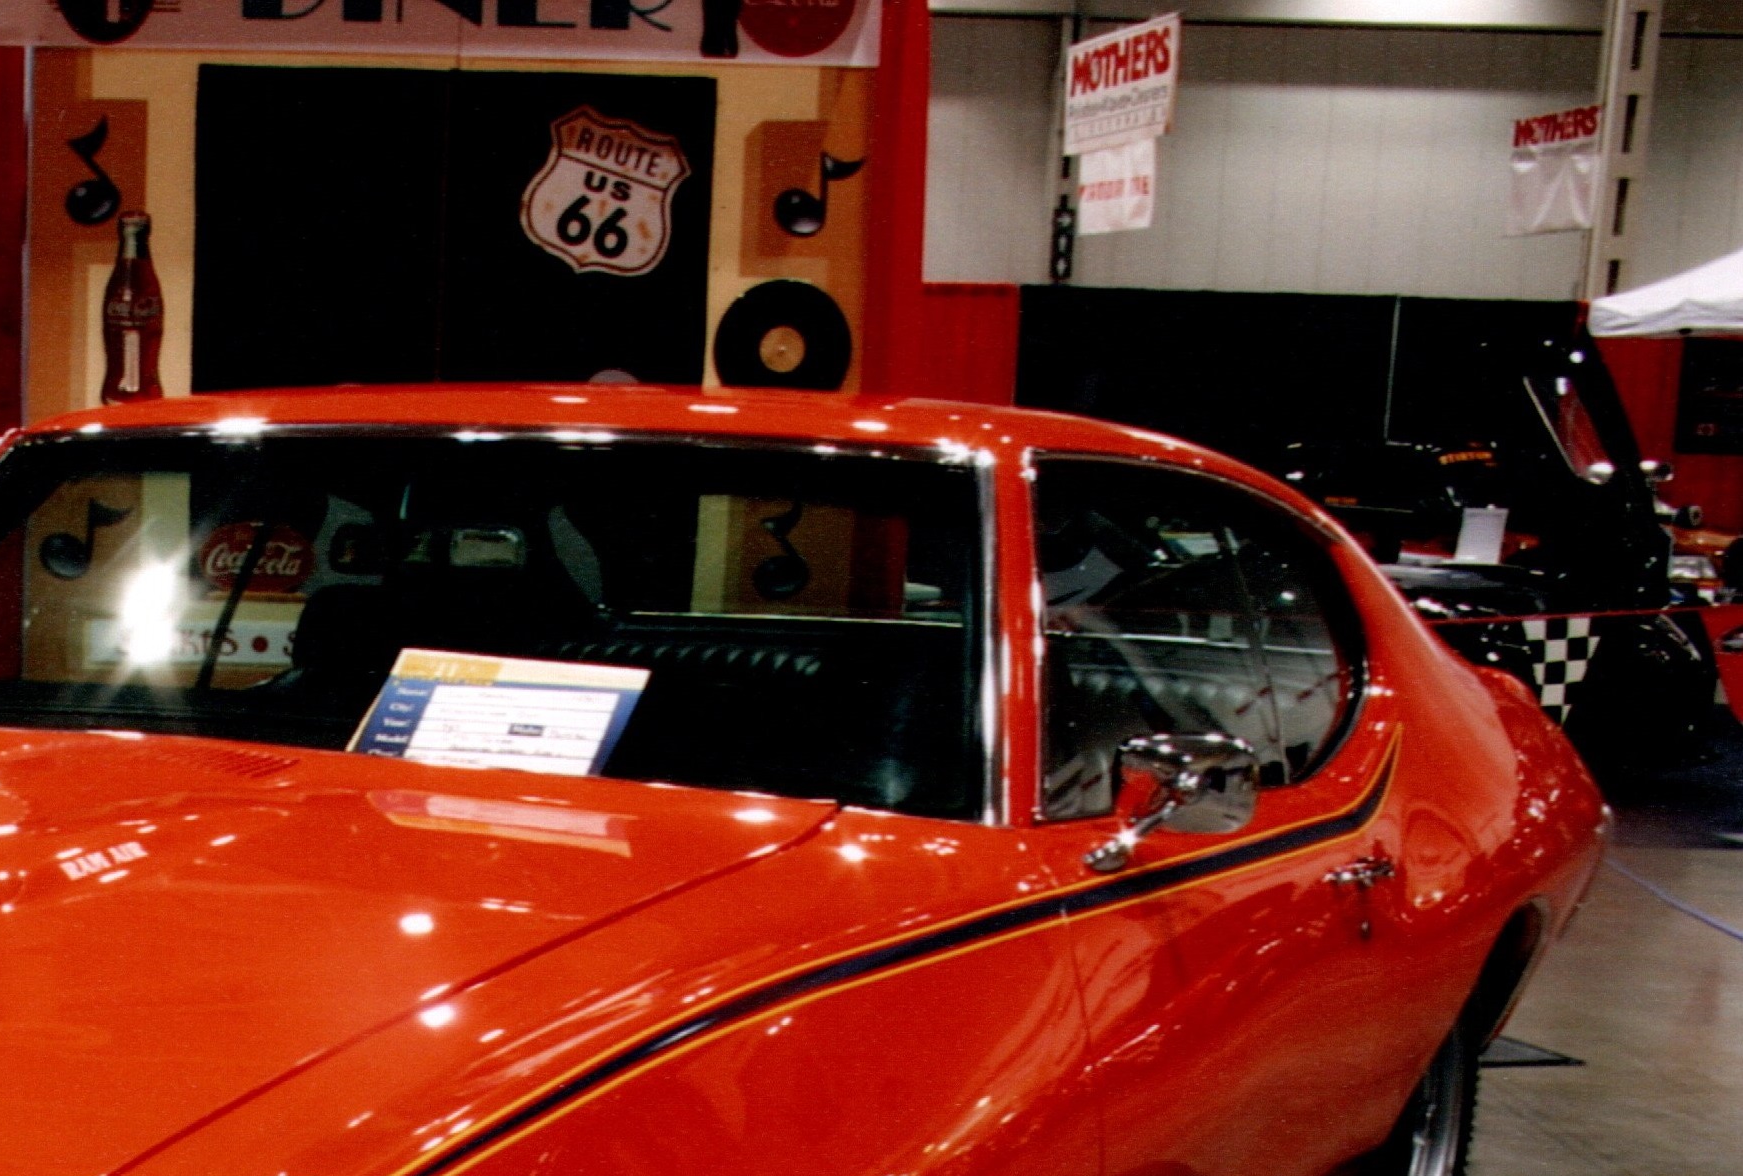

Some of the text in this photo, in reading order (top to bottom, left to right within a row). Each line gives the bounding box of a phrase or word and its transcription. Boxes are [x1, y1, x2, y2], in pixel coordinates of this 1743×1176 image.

[1069, 26, 1171, 97] MOTHERS
[1513, 105, 1600, 148] MOTHERS
[576, 127, 662, 178] ROUTE
[584, 170, 632, 202] US
[557, 195, 629, 259] 66
[59, 841, 148, 881] RAM AIR
